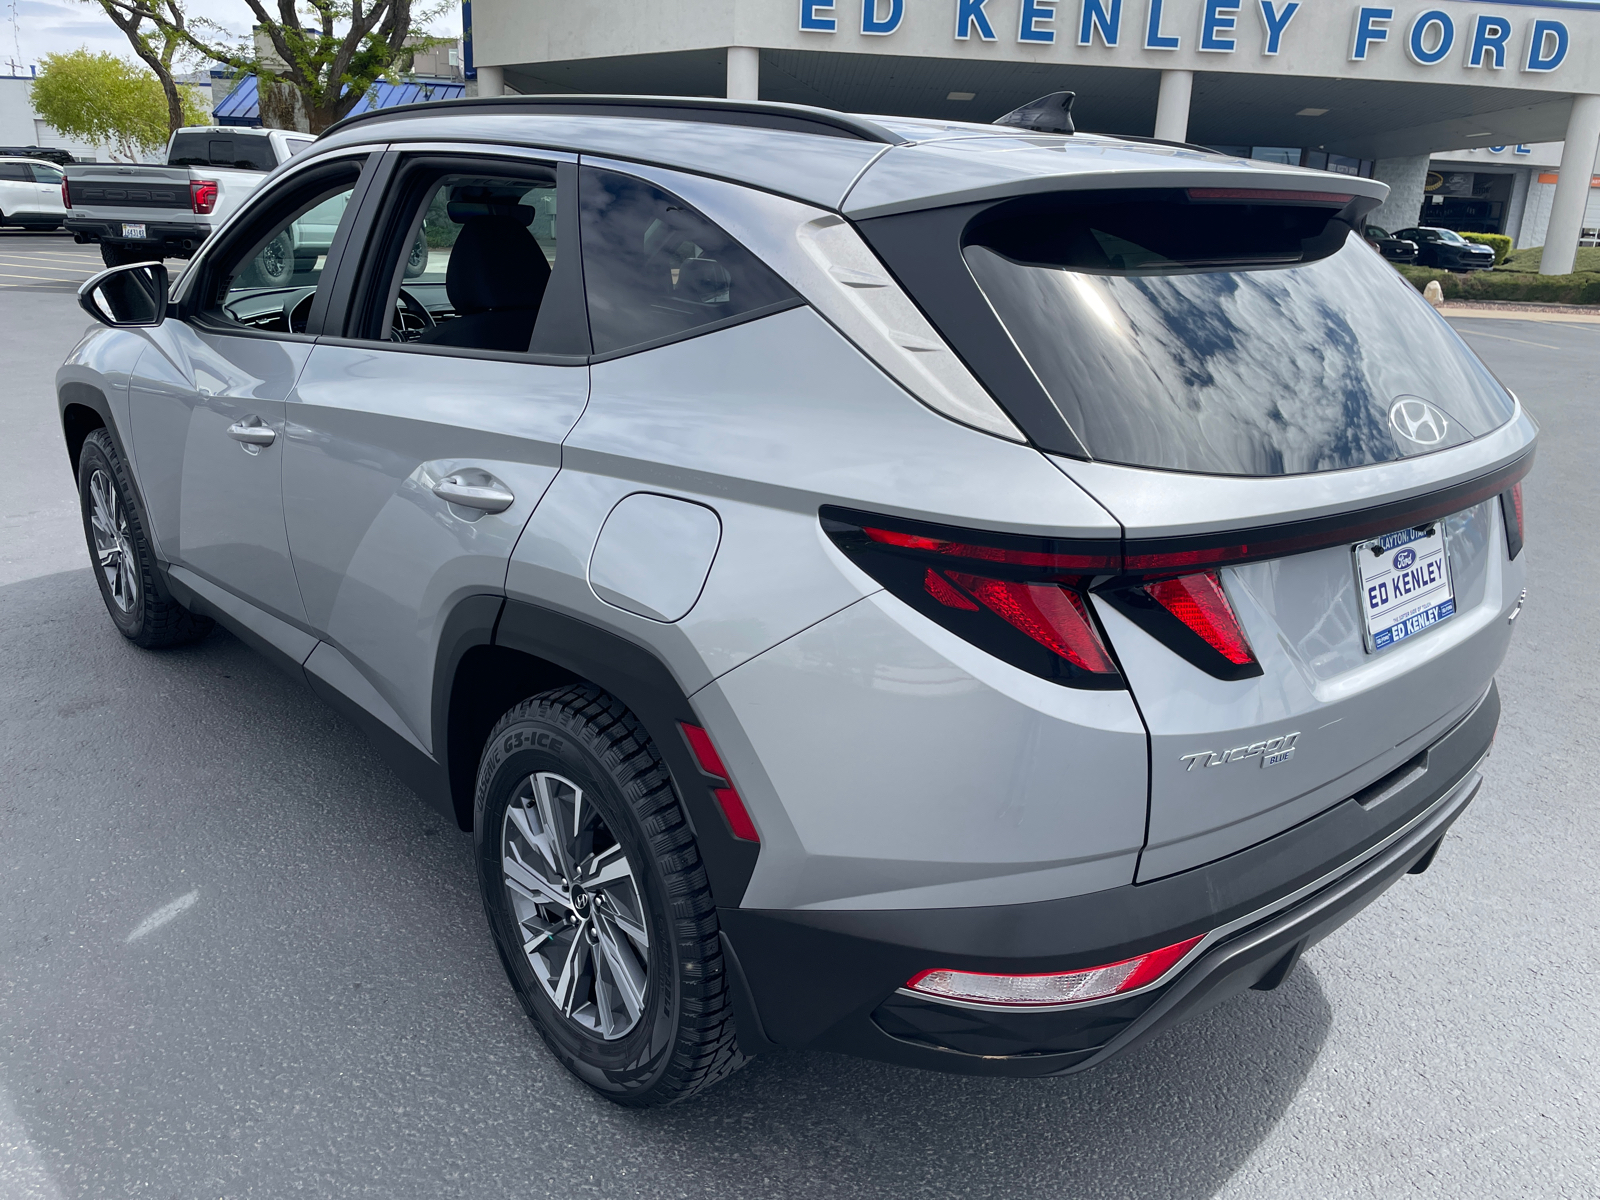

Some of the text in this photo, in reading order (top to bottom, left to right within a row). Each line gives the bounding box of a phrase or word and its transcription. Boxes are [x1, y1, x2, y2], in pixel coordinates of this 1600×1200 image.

[799, 0, 1570, 73] ED KENLEY FORD
[82, 188, 176, 201] FORD
[1396, 551, 1413, 569] Ford
[1367, 557, 1442, 609] ED KENLEY
[1391, 623, 1405, 642] ED
[1406, 606, 1439, 635] KENLEY
[503, 731, 564, 754] G3-ICE
[1179, 731, 1301, 772] TUCSON
[1269, 752, 1289, 765] BLUE
